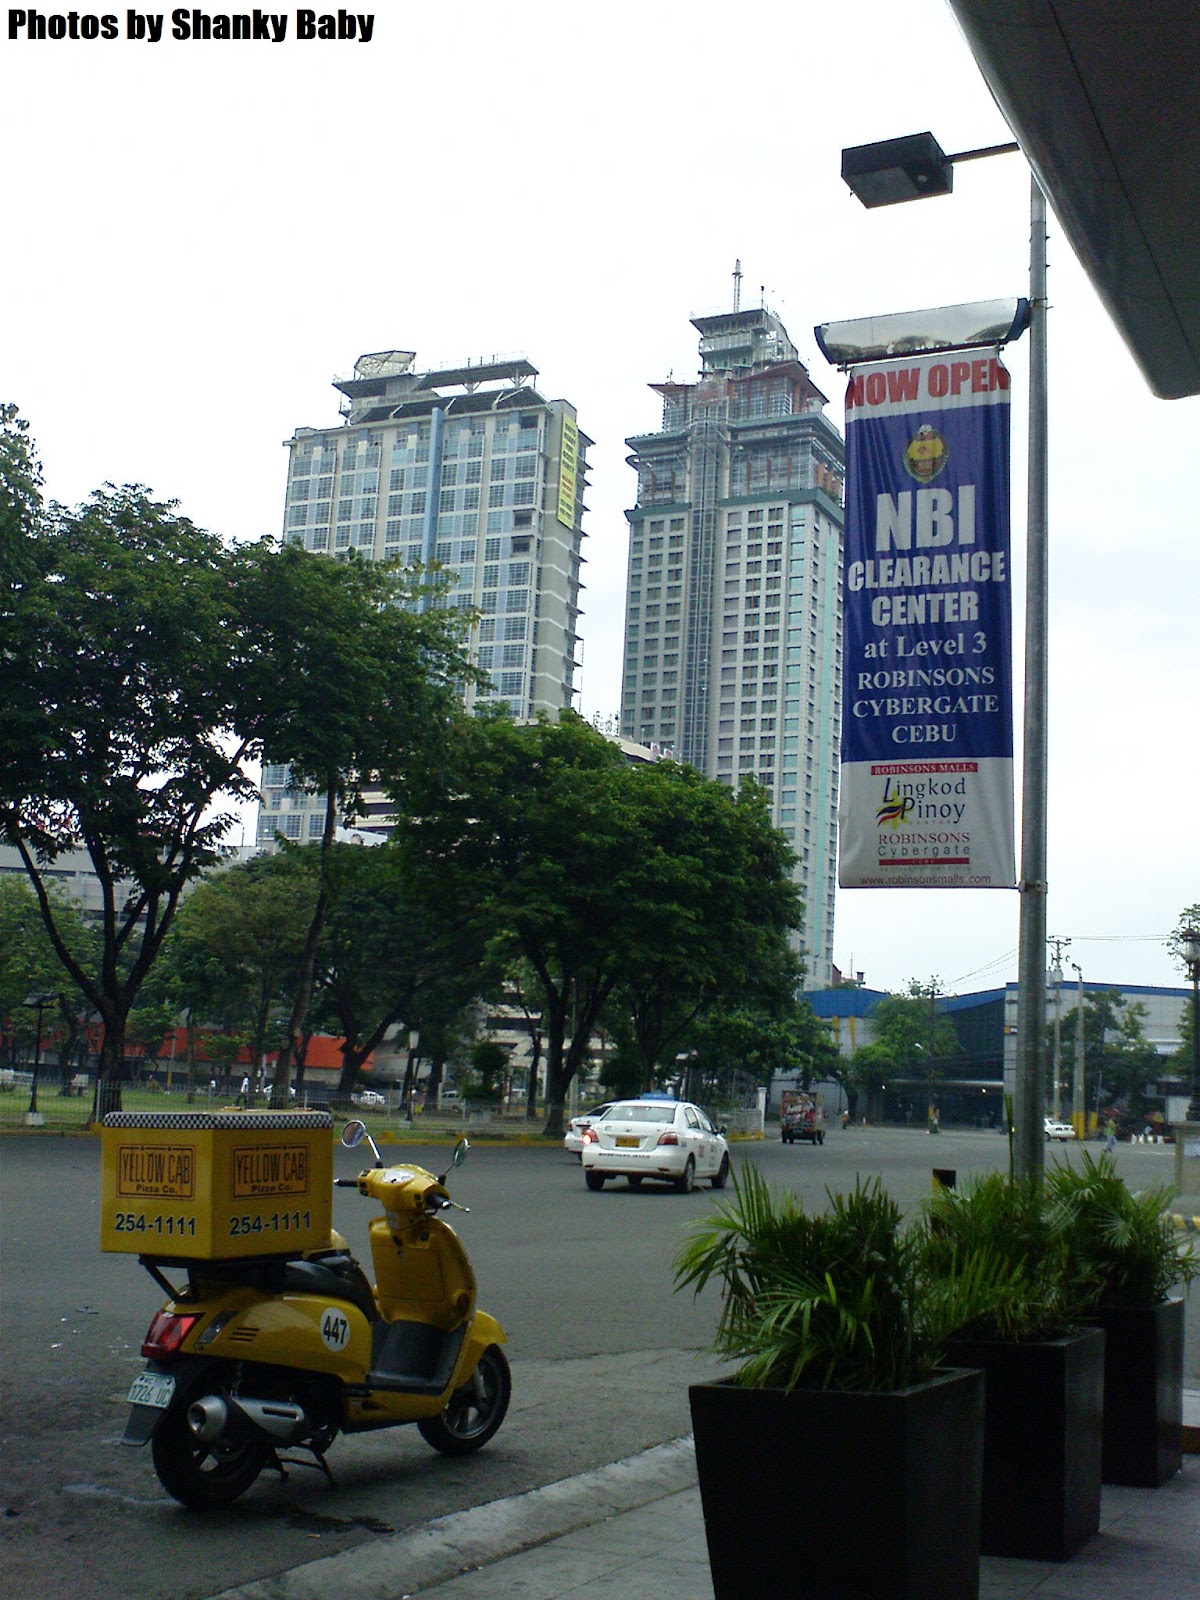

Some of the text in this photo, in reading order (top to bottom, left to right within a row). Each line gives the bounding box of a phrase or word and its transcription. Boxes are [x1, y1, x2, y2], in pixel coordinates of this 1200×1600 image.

[846, 358, 1009, 409] NOW OPEN
[876, 485, 976, 551] NBI
[848, 551, 1006, 592] CLEARANCE
[871, 591, 979, 626] CENTER
[864, 631, 988, 659] at Level 3
[858, 666, 995, 690] ROBINSONS
[853, 694, 999, 718] CYBERGATE
[892, 724, 957, 744] CEBU
[874, 762, 975, 774] ROBINSONS MALLS
[883, 777, 966, 803] Lingkod
[901, 797, 966, 824] Pinoy
[879, 832, 971, 845] ROBINSONS
[878, 845, 970, 858] Cybergate
[860, 874, 991, 885] www.robinsonsmalls.com
[123, 1152, 190, 1185] YELLOW CAB
[236, 1152, 305, 1184] YELLOW CAB
[136, 1184, 177, 1194] Pizza Co.
[251, 1183, 292, 1193] Pizza Co.
[115, 1213, 196, 1236] 254-1111
[229, 1210, 311, 1235] 254-1111
[323, 1315, 347, 1345] 447
